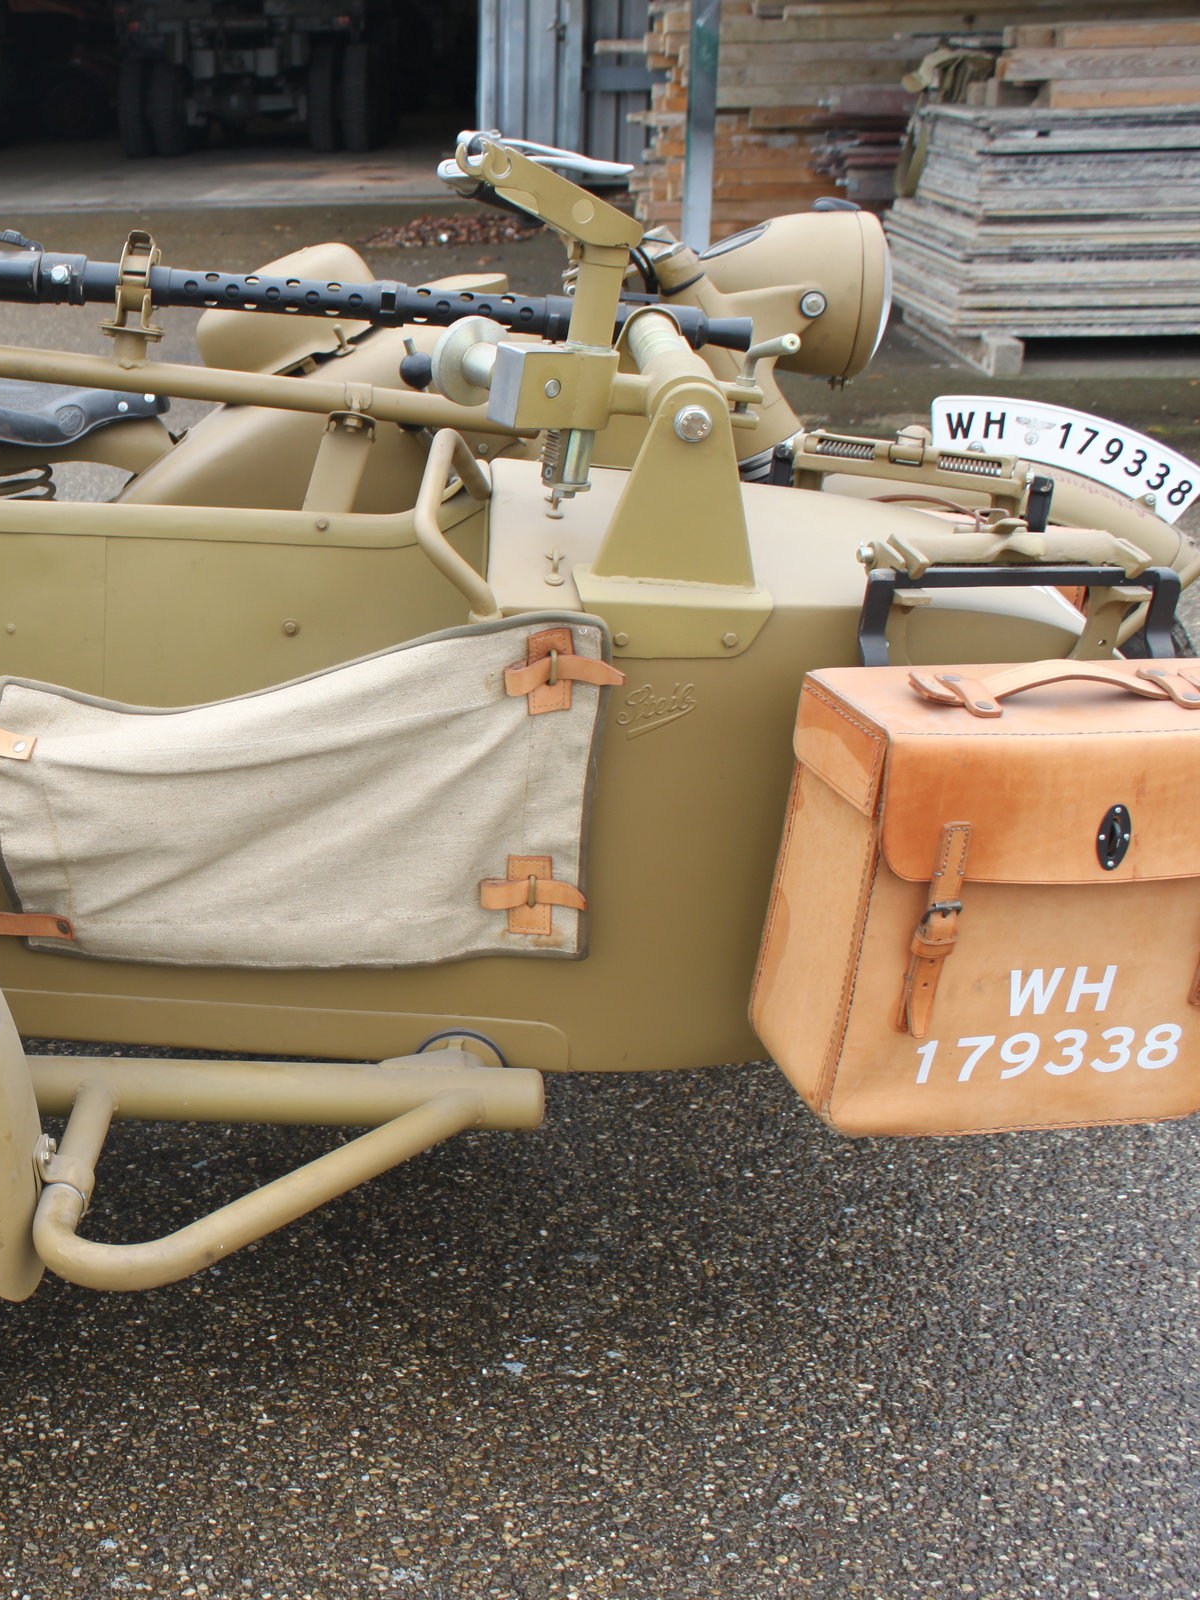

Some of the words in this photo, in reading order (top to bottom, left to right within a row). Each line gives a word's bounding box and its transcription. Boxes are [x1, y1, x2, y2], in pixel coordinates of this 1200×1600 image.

[946, 411, 1006, 440] WH
[1058, 422, 1193, 506] 179338
[1009, 965, 1118, 1017] WH
[915, 1023, 1183, 1084] 179338
